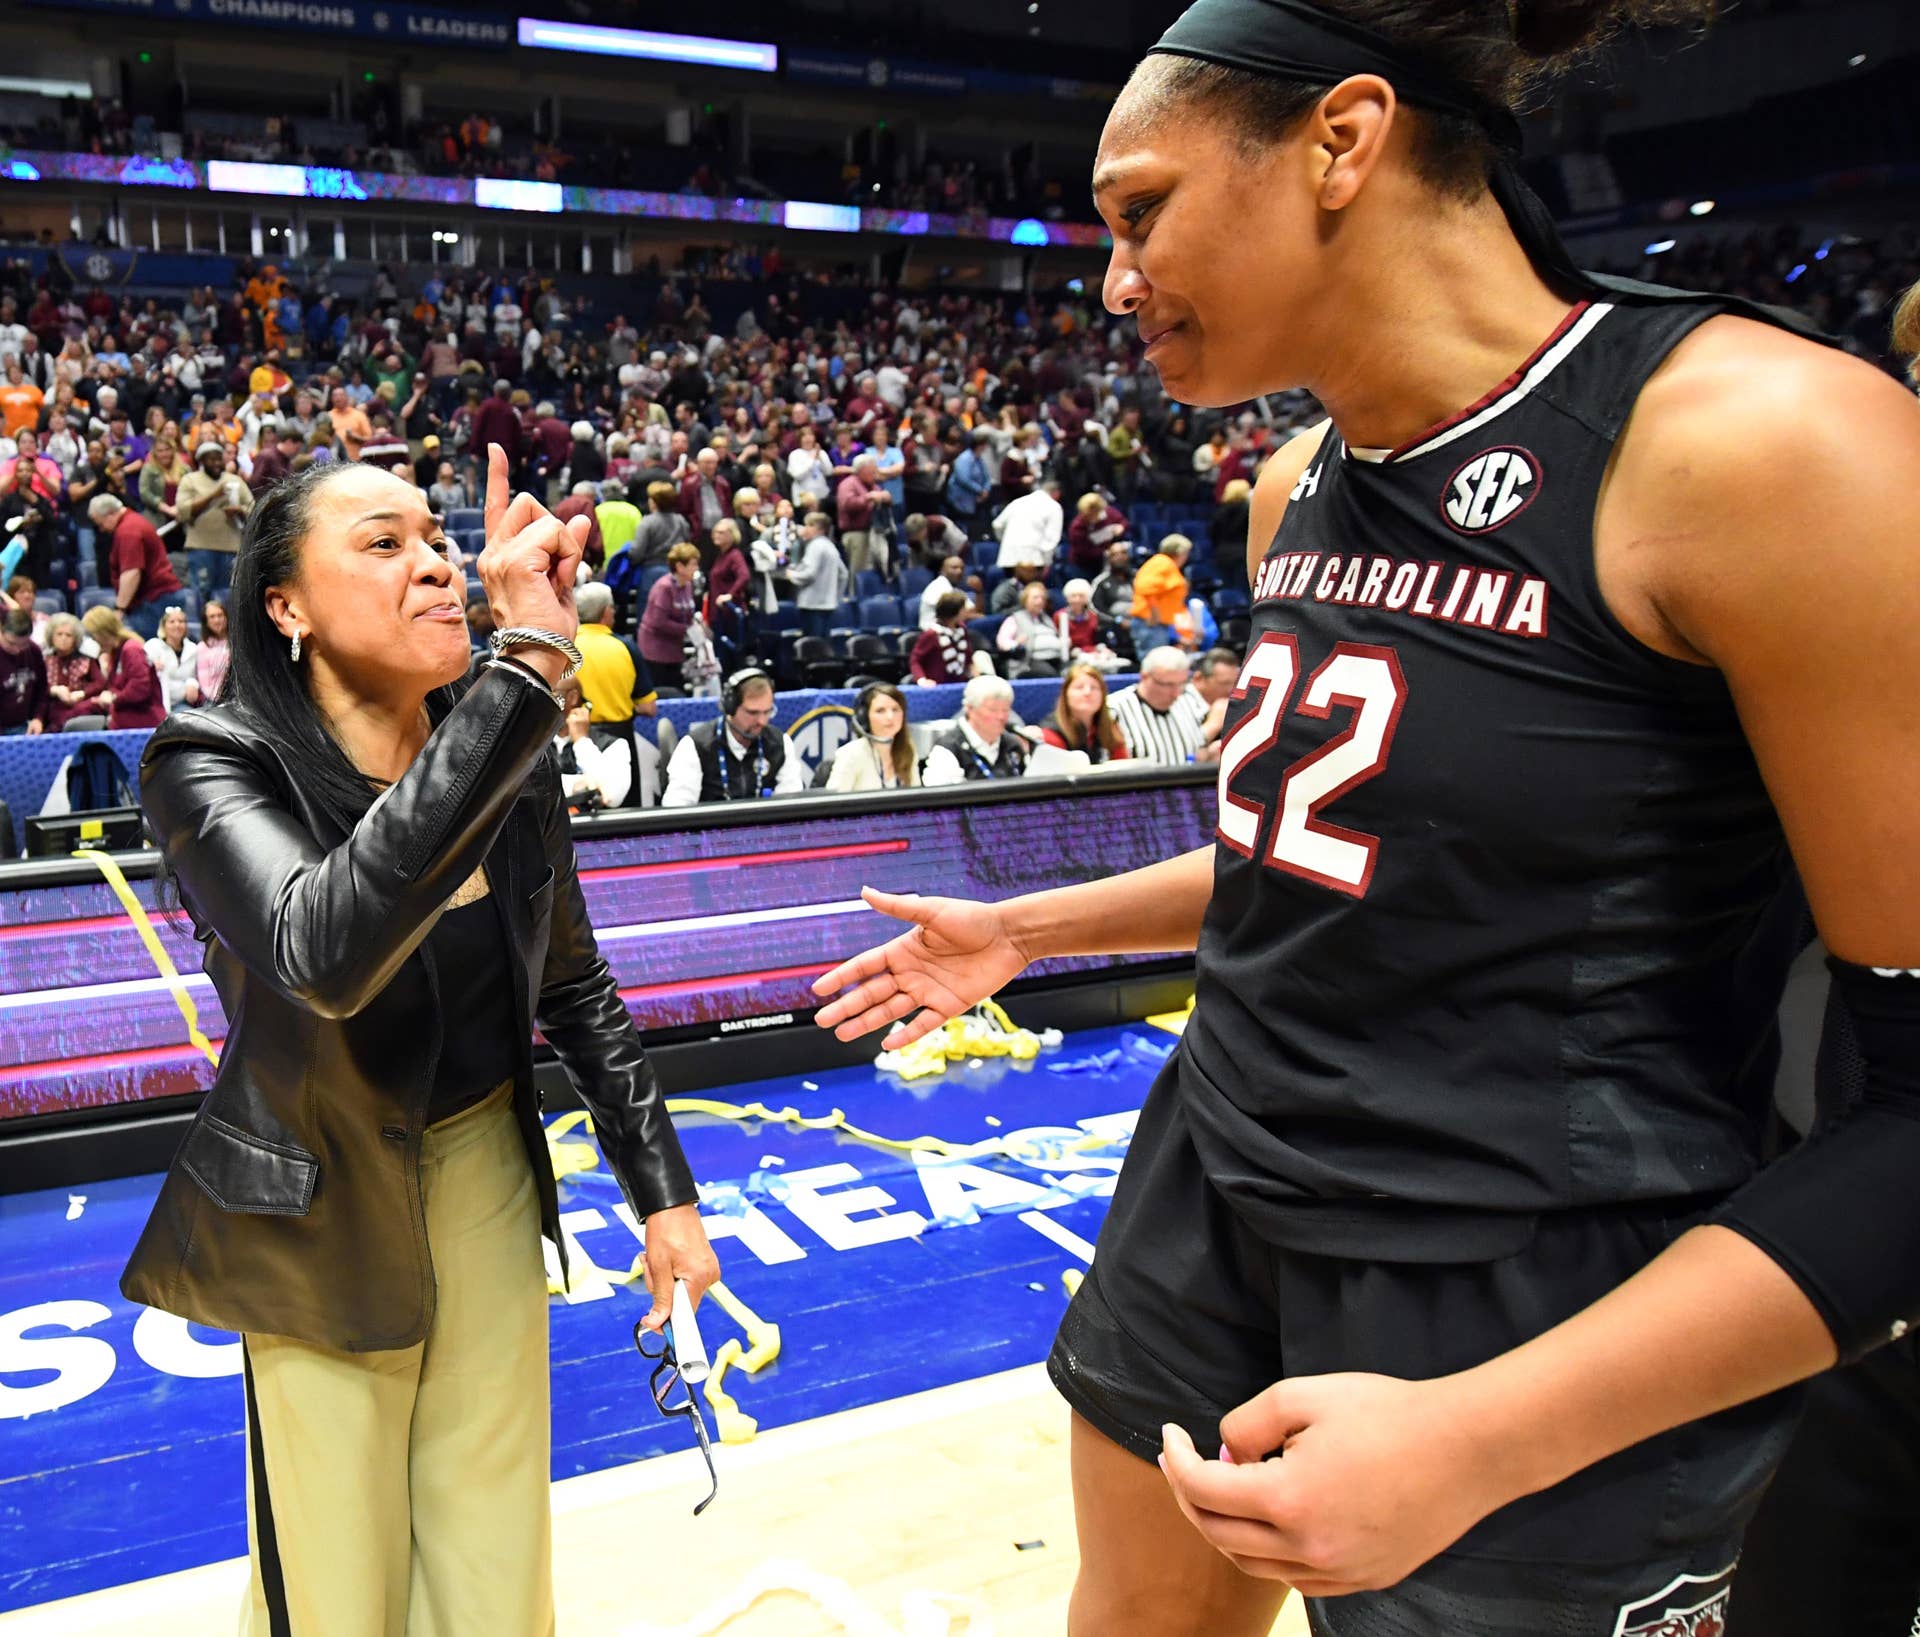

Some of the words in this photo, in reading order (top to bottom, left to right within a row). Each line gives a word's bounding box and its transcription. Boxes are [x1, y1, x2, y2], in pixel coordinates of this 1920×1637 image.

[209, 0, 355, 26] CHAMPIONS
[407, 15, 509, 41] LEADERS
[1446, 451, 1533, 528] SEC
[1254, 552, 1321, 602] SOUTH
[1314, 553, 1548, 638] CAROLINA
[1217, 631, 1408, 899] 22
[720, 1013, 794, 1032] DAKTRONICS
